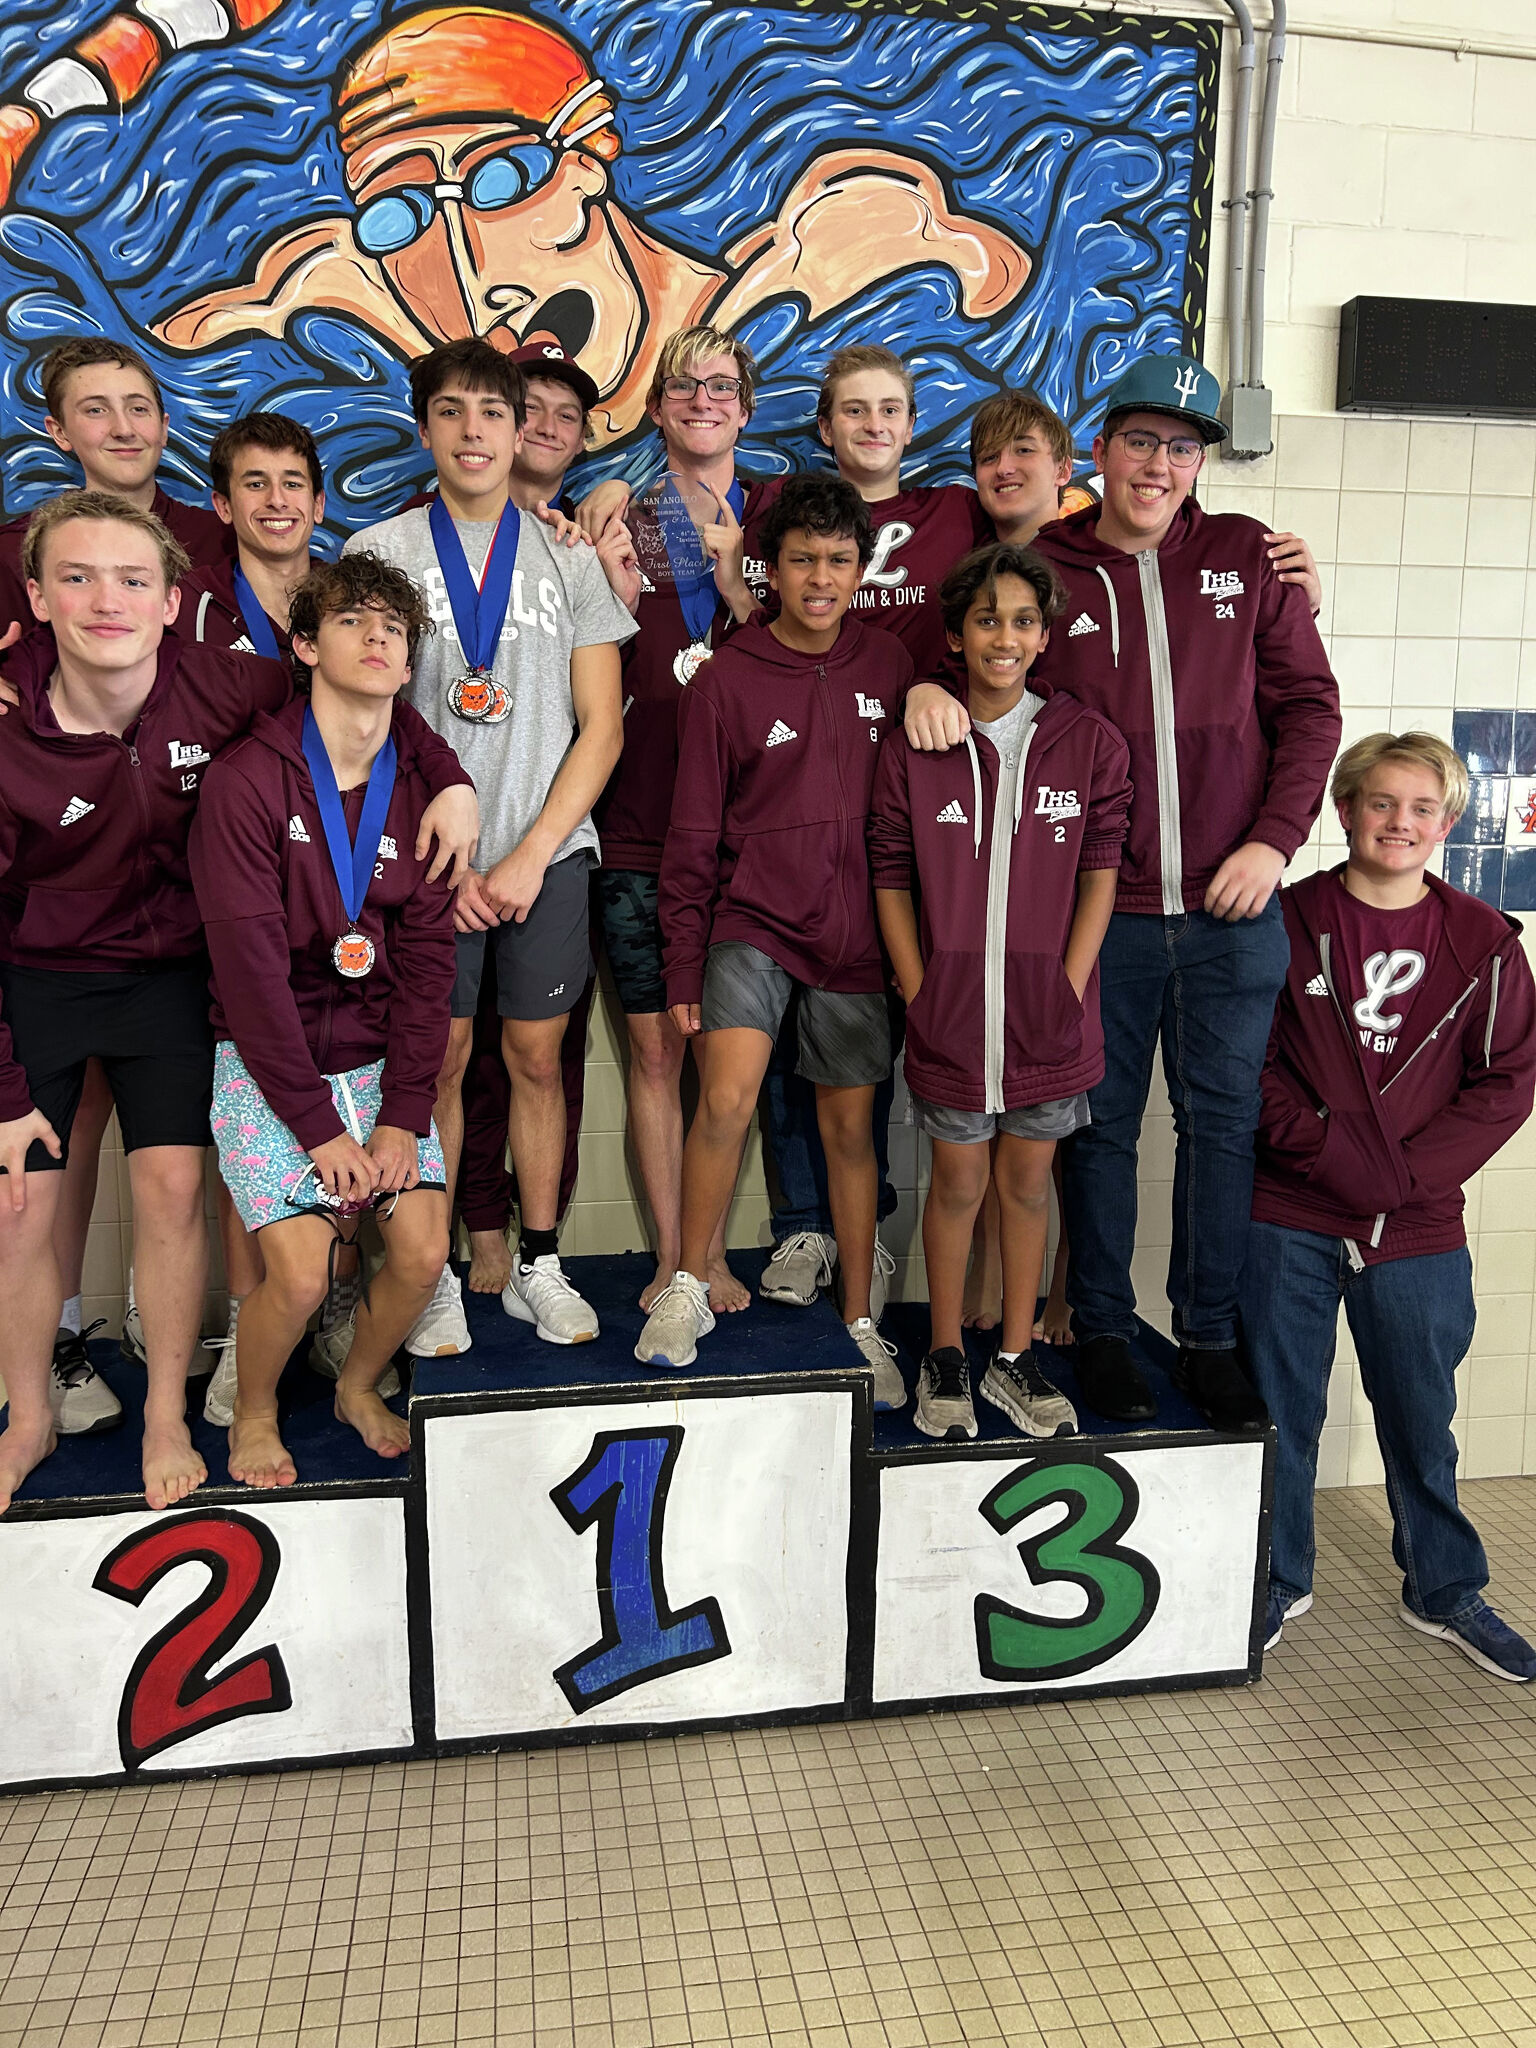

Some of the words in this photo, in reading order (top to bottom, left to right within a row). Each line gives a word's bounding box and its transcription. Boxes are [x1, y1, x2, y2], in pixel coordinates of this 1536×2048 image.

[644, 497, 660, 505] SAN
[663, 495, 697, 504] ANGELO
[645, 557, 671, 569] First
[673, 556, 704, 568] Place
[848, 589, 875, 609] WIM
[880, 589, 891, 607] &
[896, 586, 926, 606] DIVE
[1215, 603, 1235, 618] 24
[1068, 624, 1100, 637] adidas
[766, 730, 797, 747] adidas
[870, 727, 878, 742] 8
[181, 773, 197, 791] 12
[60, 803, 95, 826] adidas
[936, 815, 968, 824] adidas
[1054, 826, 1065, 842] 2
[378, 835, 397, 853] HS
[1352, 949, 1426, 1033] L
[549, 1425, 732, 1715] 1
[974, 1455, 1161, 1682] 3
[92, 1508, 292, 1772] 2
